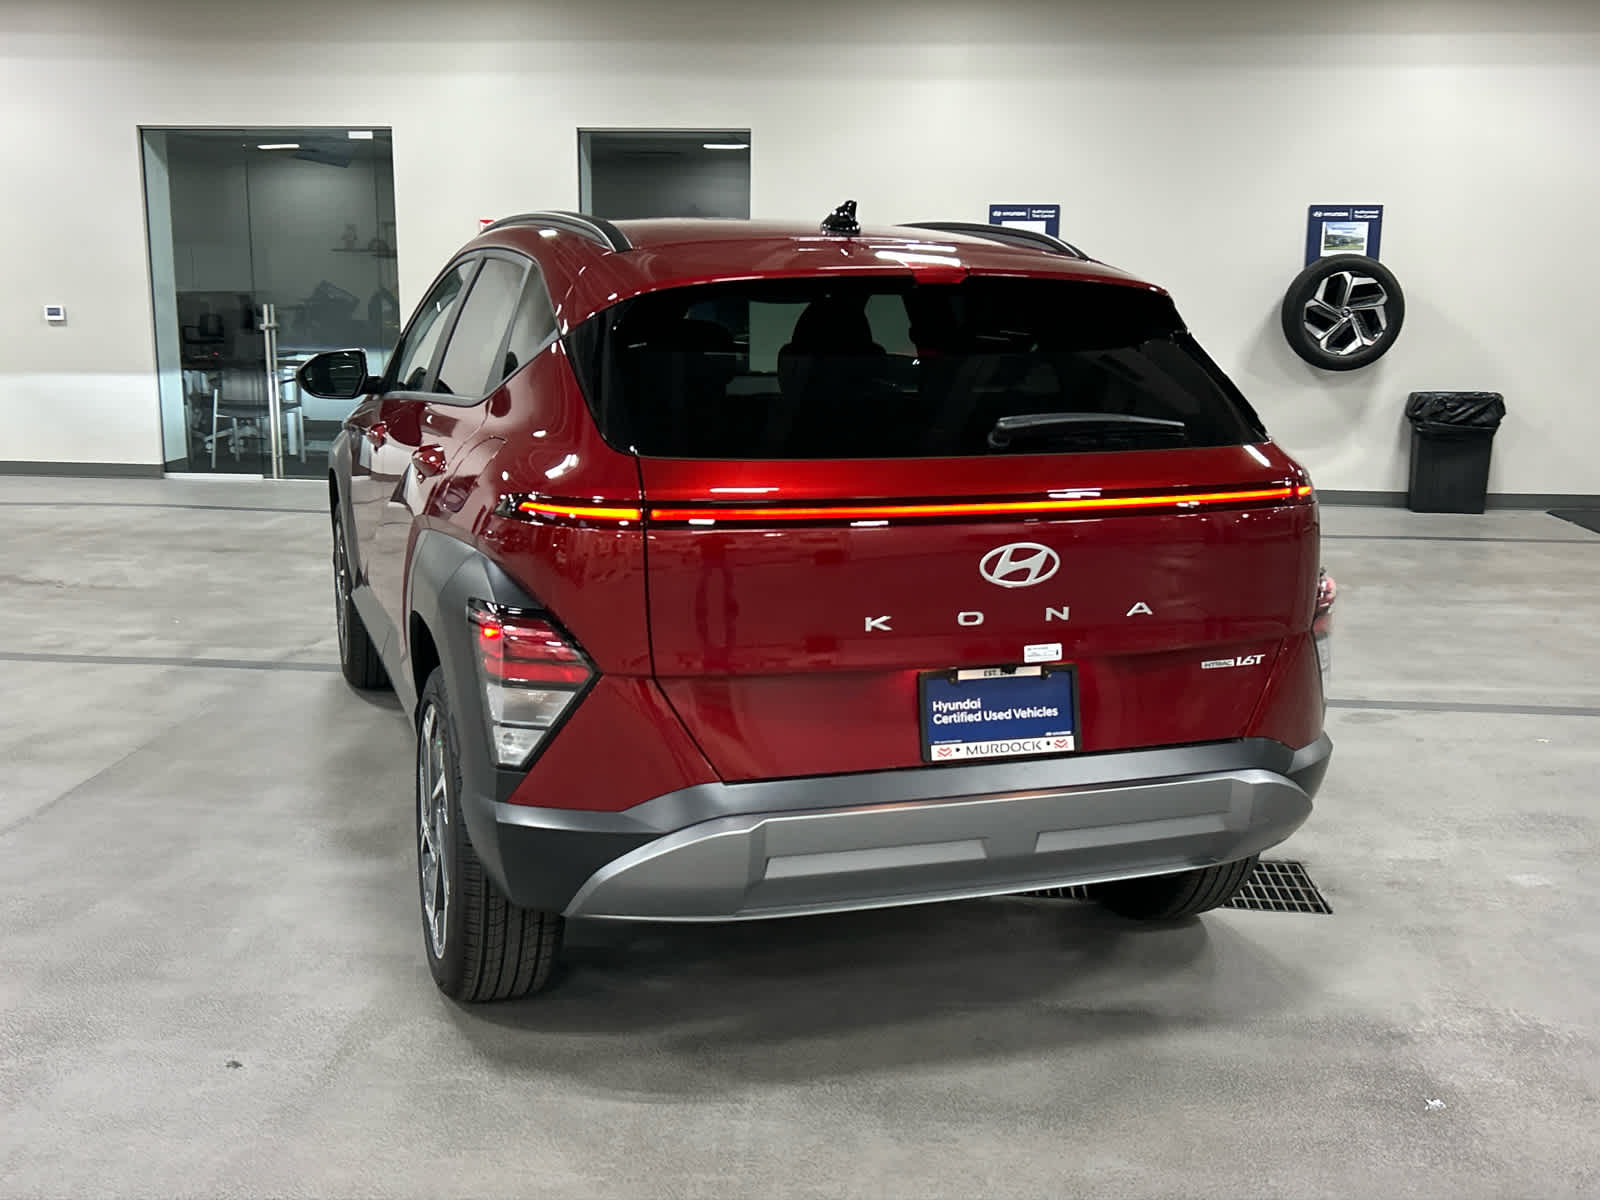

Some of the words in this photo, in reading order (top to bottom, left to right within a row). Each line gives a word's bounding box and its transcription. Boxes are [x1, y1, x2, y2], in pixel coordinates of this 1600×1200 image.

[932, 698, 982, 713] Hyundai
[933, 711, 982, 725] Certified
[983, 708, 1013, 721] Used
[1012, 706, 1059, 719] Vehicles
[965, 740, 1042, 756] MURDOCK
